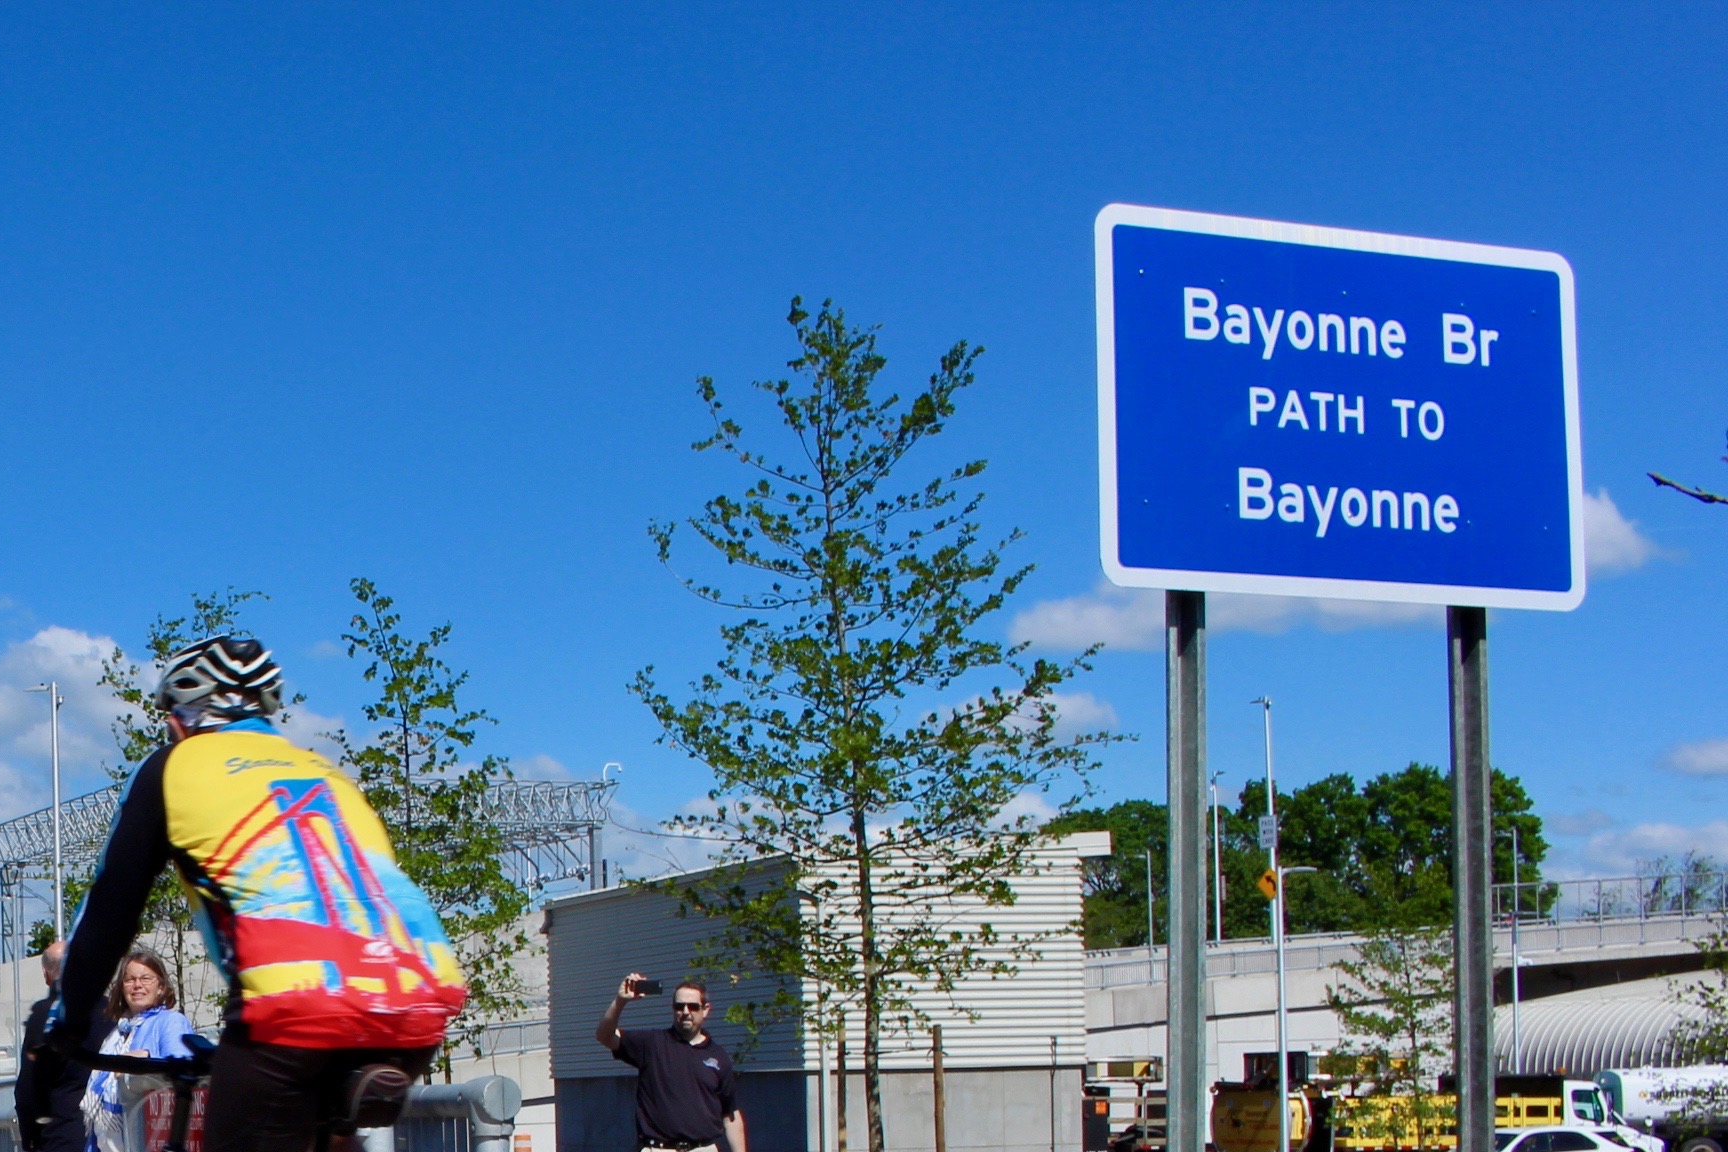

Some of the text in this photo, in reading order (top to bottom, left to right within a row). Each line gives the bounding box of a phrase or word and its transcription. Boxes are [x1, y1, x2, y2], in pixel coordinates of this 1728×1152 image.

[1182, 286, 1500, 367] Bayonne Br
[1248, 386, 1446, 441] PATH TO
[1237, 467, 1460, 538] Bayonne
